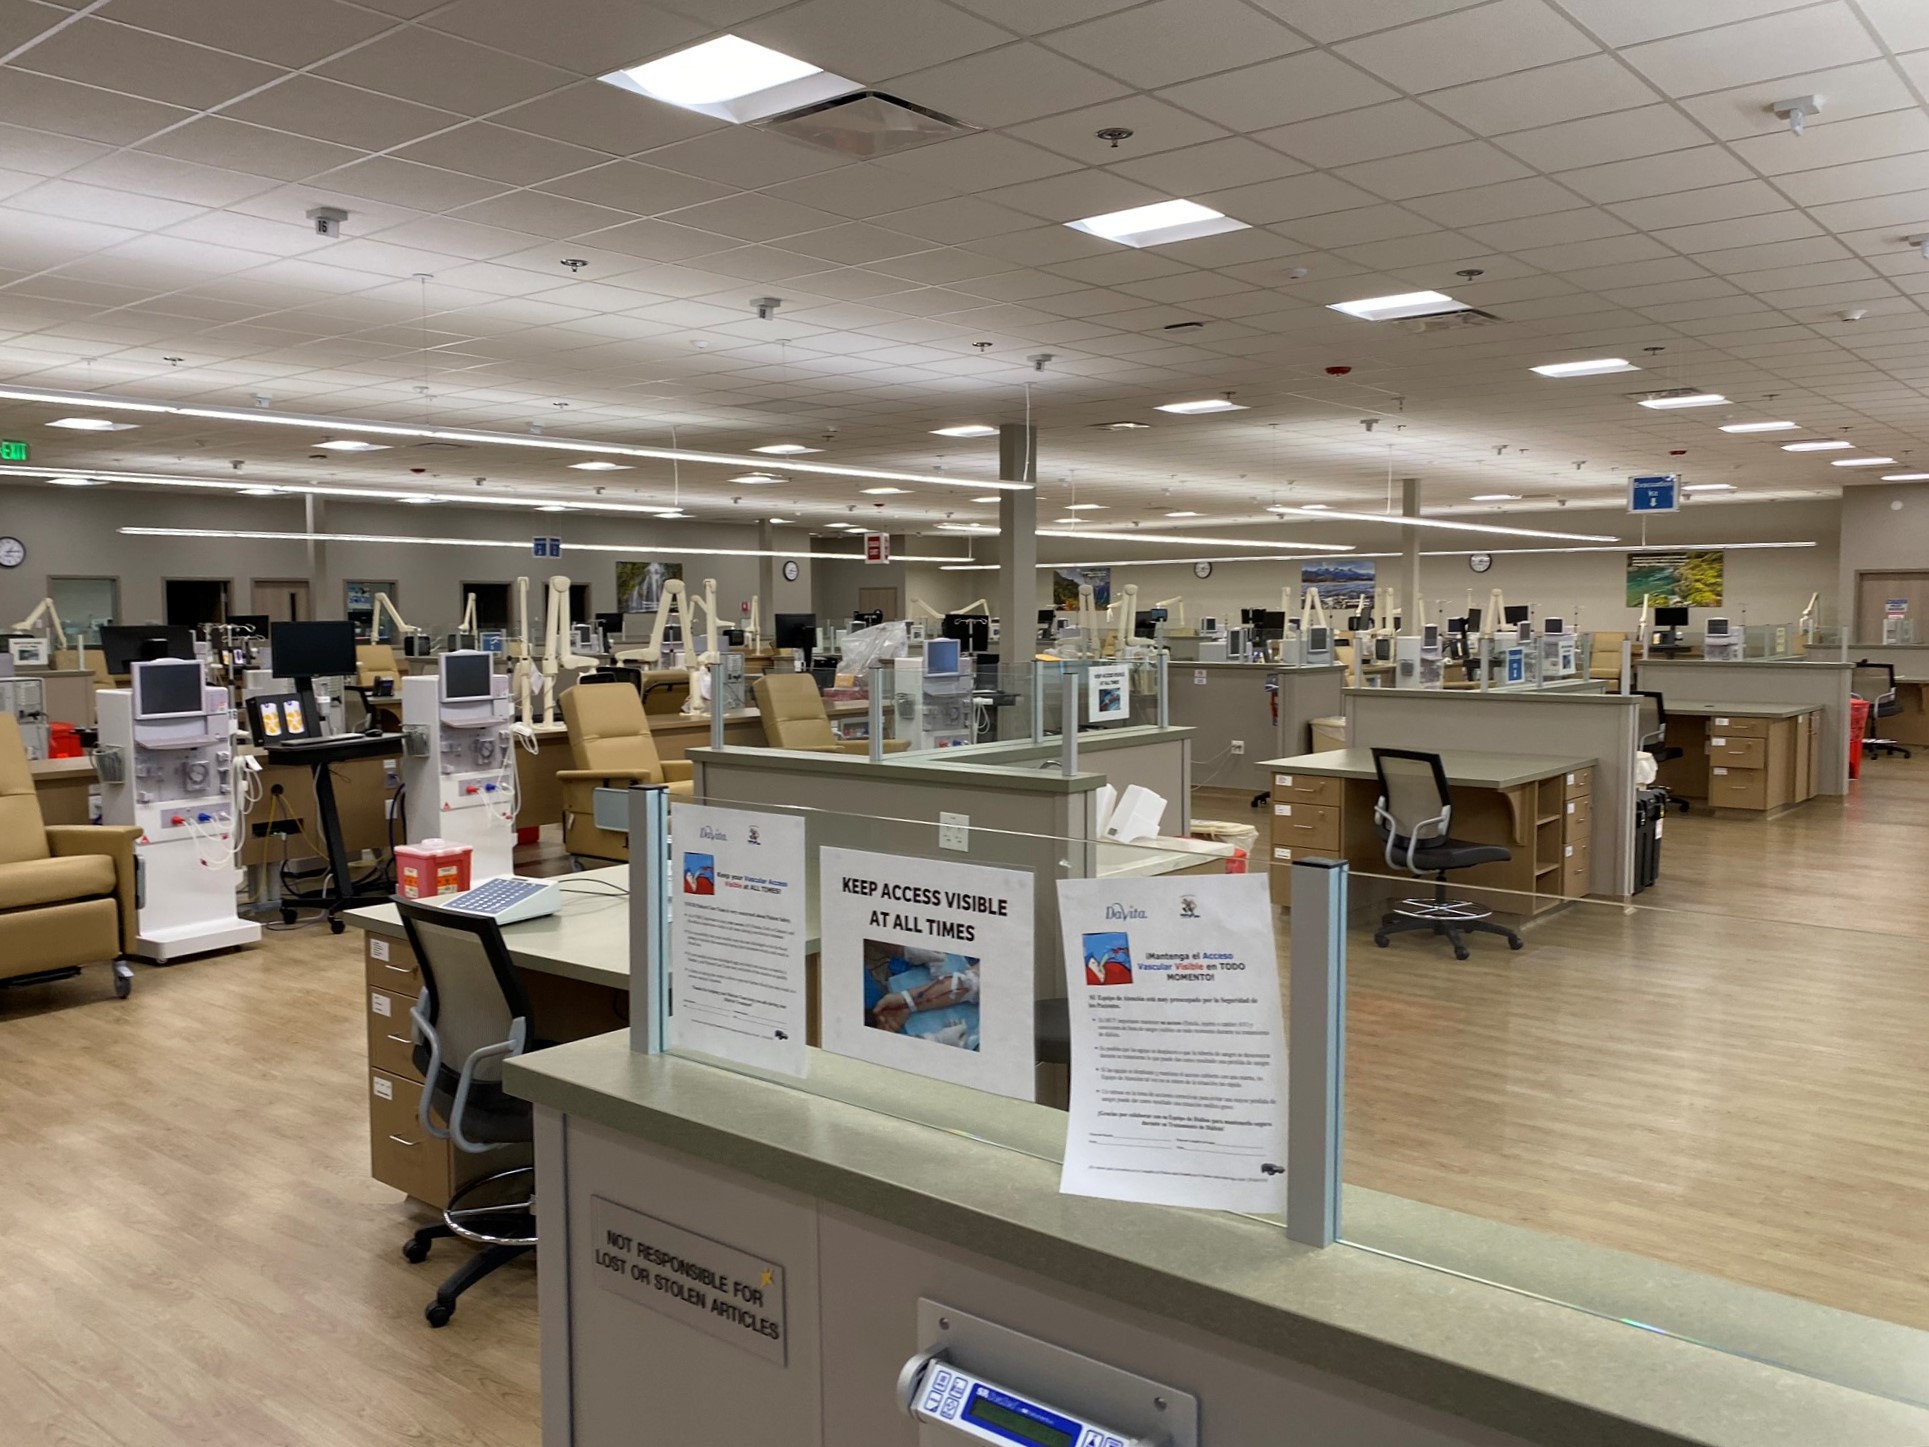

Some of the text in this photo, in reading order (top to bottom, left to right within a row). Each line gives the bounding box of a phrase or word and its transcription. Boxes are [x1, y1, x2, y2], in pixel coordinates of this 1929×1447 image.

[318, 220, 328, 233] 16
[716, 872, 730, 880] Keep
[768, 879, 788, 887] Access
[842, 877, 1008, 917] KEEP ACCESS VISIBLE
[869, 910, 975, 942] AT ALL TIMES
[1137, 962, 1172, 971] Vascular
[1174, 962, 1204, 971] Visible
[1219, 962, 1246, 971] TODO
[1202, 952, 1234, 960] Acceso
[607, 1230, 763, 1308] NOT RESPONSIBLE FOR
[595, 1249, 780, 1340] LOST OR STOLEN ARTICLES
